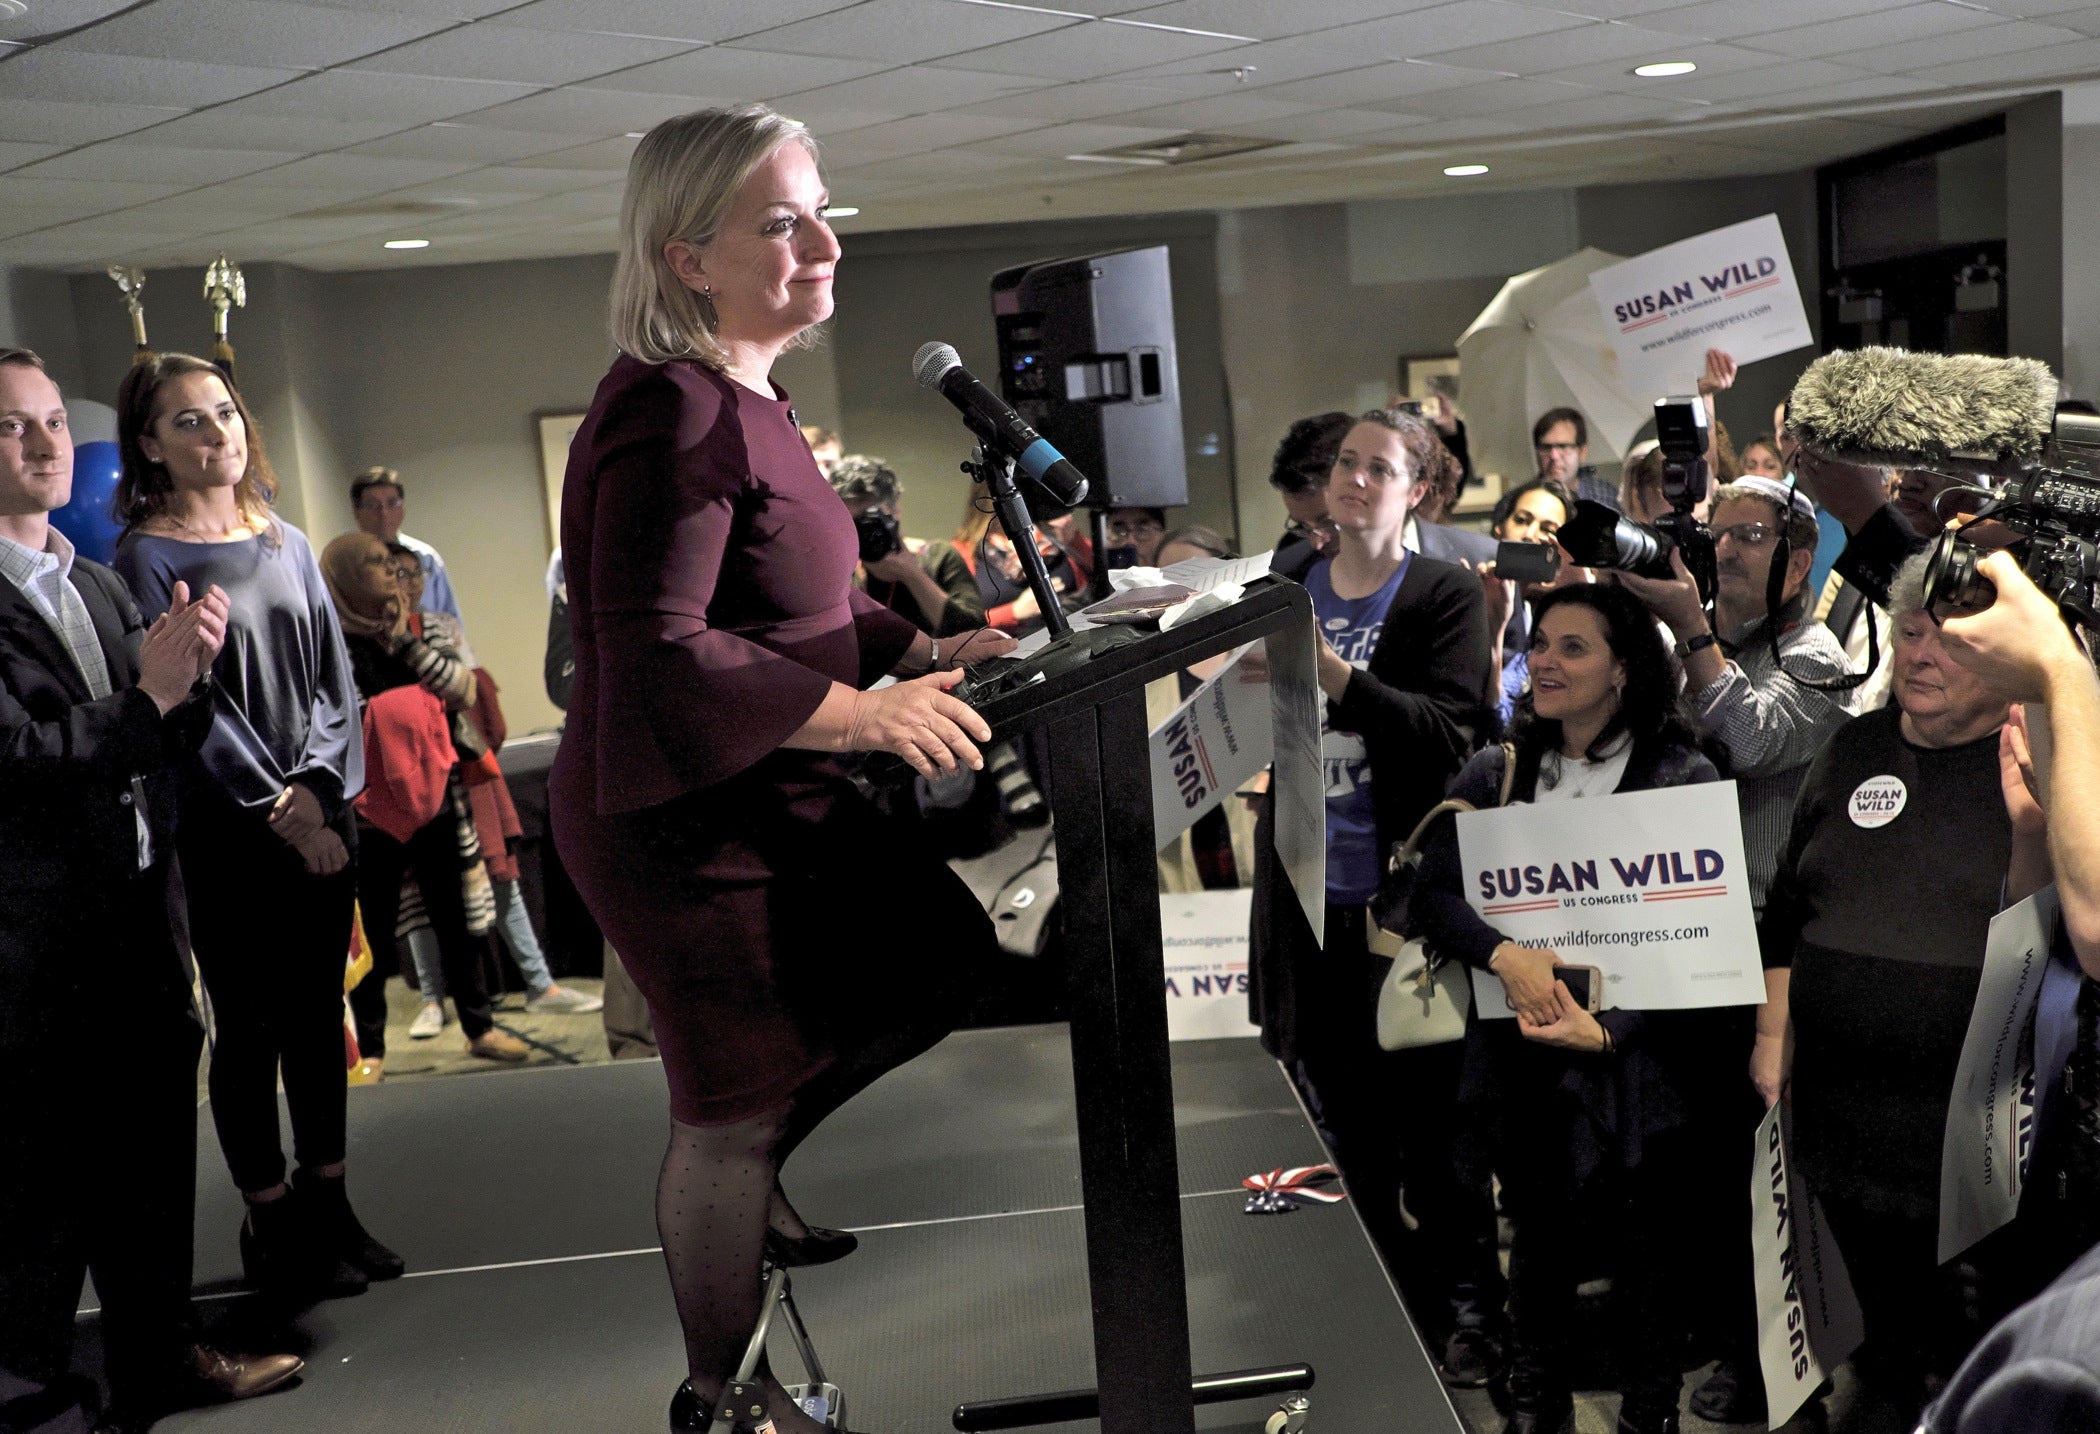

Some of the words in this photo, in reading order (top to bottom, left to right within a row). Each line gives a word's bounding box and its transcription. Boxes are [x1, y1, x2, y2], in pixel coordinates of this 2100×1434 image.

[1614, 282, 1694, 324] SUSAN
[1700, 256, 1777, 293] WILD
[1641, 304, 1772, 352] www.wildforcongress.com
[1165, 715, 1207, 809] SUSAN
[1855, 789, 1902, 801] SUSAN
[1857, 801, 1896, 811] WILD
[1479, 859, 1600, 900] SUSAN
[1609, 848, 1725, 887] WILD
[1563, 898, 1577, 908] US
[1581, 894, 1639, 907] CONGRESS
[1193, 973, 1249, 997] SAN
[1985, 948, 2034, 1186] www.wildforcongress.com
[1769, 1121, 1788, 1241] WILD
[1780, 1243, 1808, 1381] SUSAN
